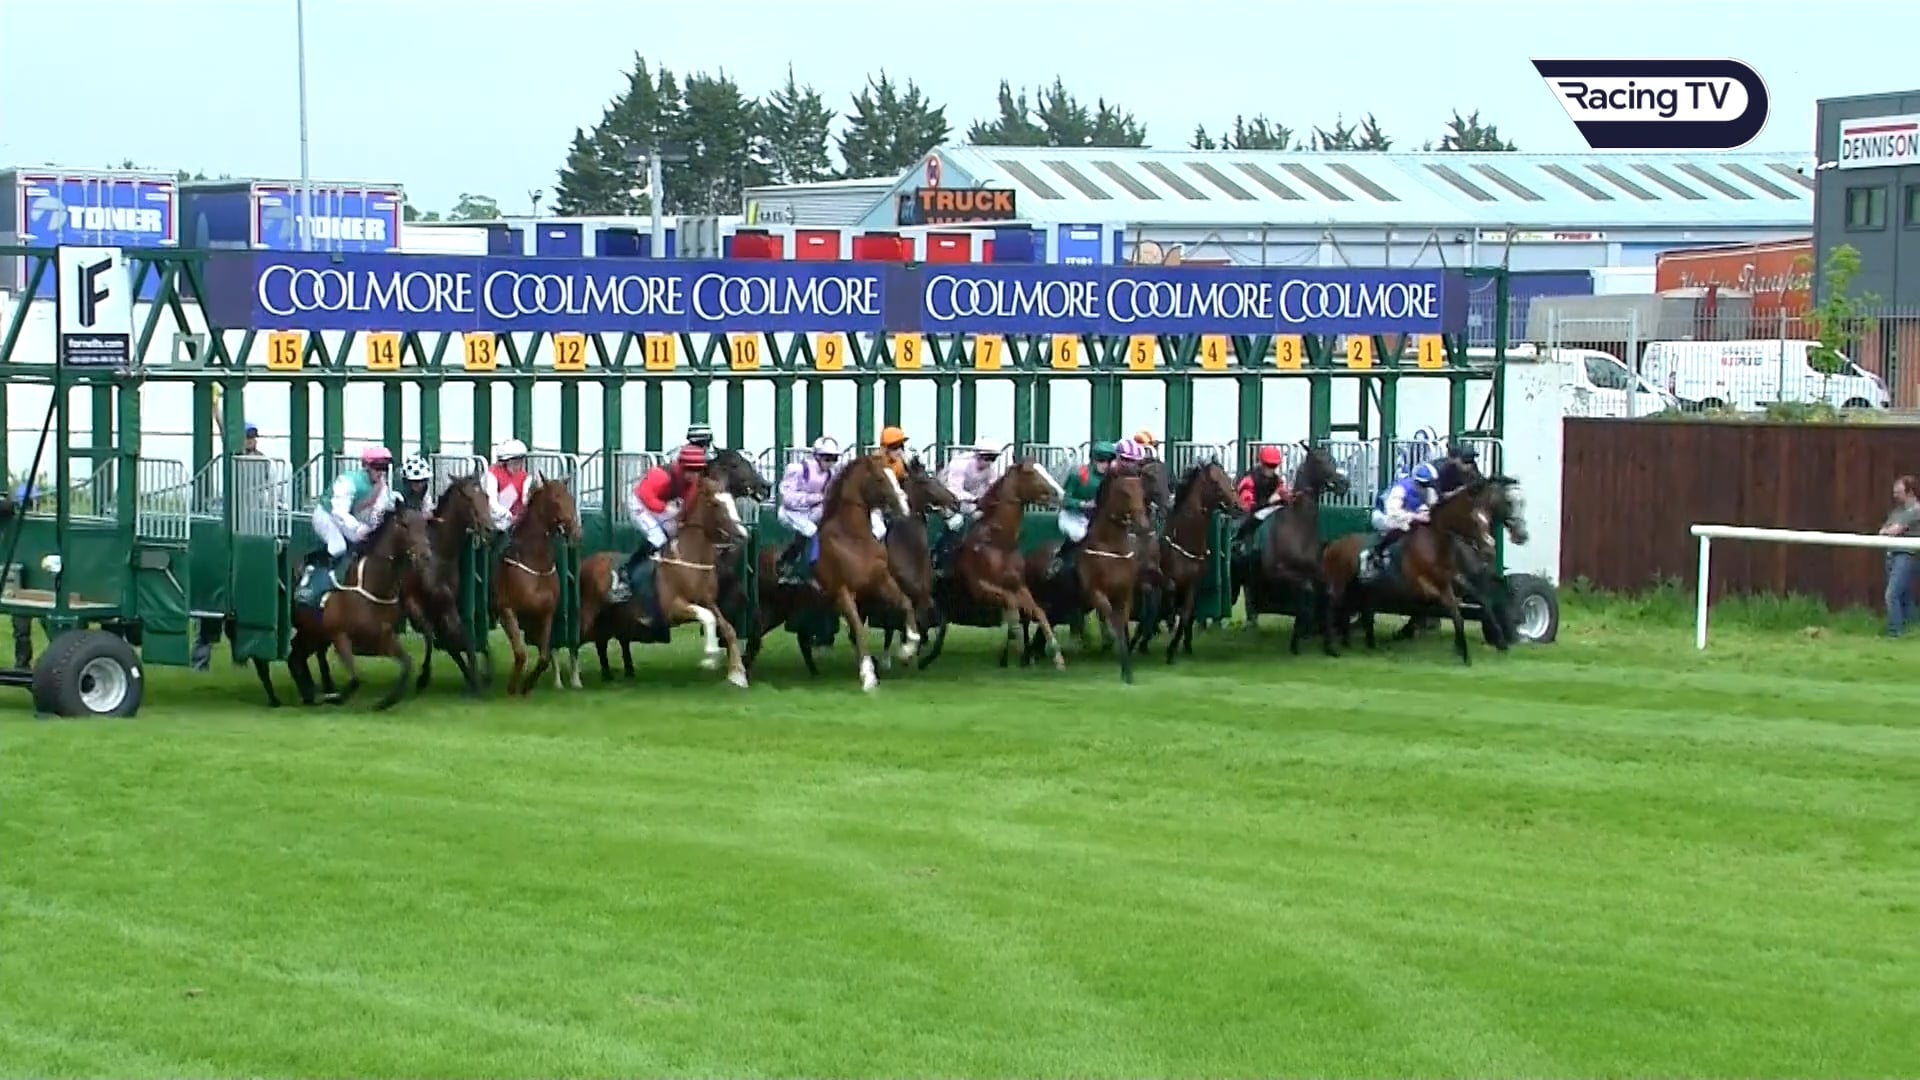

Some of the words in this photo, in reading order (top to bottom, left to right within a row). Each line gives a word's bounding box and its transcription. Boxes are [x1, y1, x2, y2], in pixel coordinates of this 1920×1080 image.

[1842, 133, 1919, 160] DENNISON
[919, 190, 1013, 212] TRUCK
[67, 205, 162, 232] TONER
[273, 339, 297, 364] 15
[371, 339, 394, 364] 14
[468, 339, 491, 364] 13
[557, 340, 580, 364] 12
[651, 340, 670, 364] 11
[735, 340, 756, 364] 10
[825, 340, 836, 364] 9
[903, 339, 914, 363] 8
[983, 341, 993, 363] 7
[1061, 340, 1071, 362] 6
[1136, 341, 1147, 364] 5
[1208, 341, 1218, 363] 4
[1283, 340, 1293, 362] 3
[1353, 340, 1363, 362] 2
[1426, 341, 1433, 362] 1
